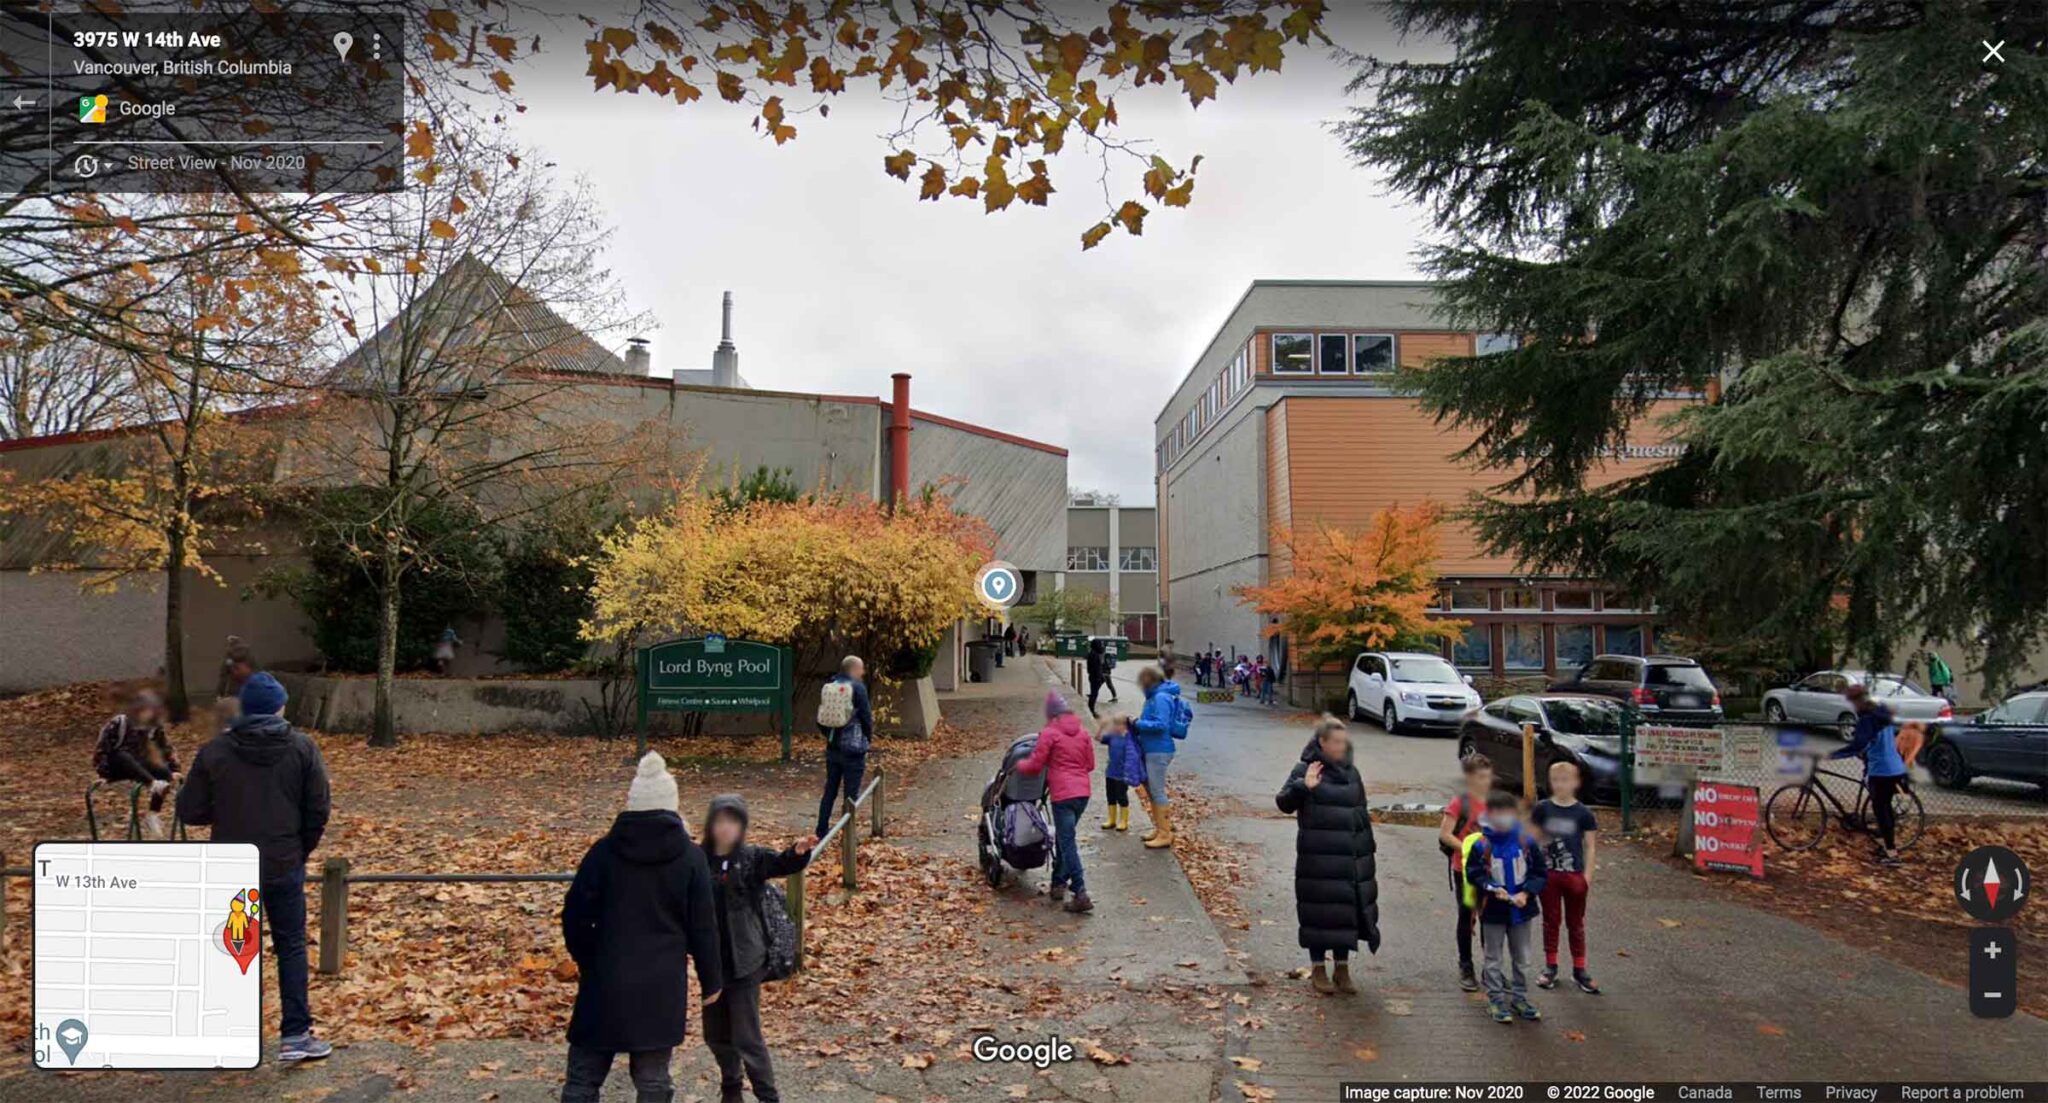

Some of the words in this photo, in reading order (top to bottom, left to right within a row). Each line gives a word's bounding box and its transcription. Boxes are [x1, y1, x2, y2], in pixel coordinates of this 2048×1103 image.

[659, 659, 692, 674] Lord
[697, 659, 733, 677] Byng
[738, 658, 771, 674] Pool
[1694, 787, 1717, 804] NO
[1694, 810, 1718, 827] NO
[1695, 834, 1719, 852] NO
